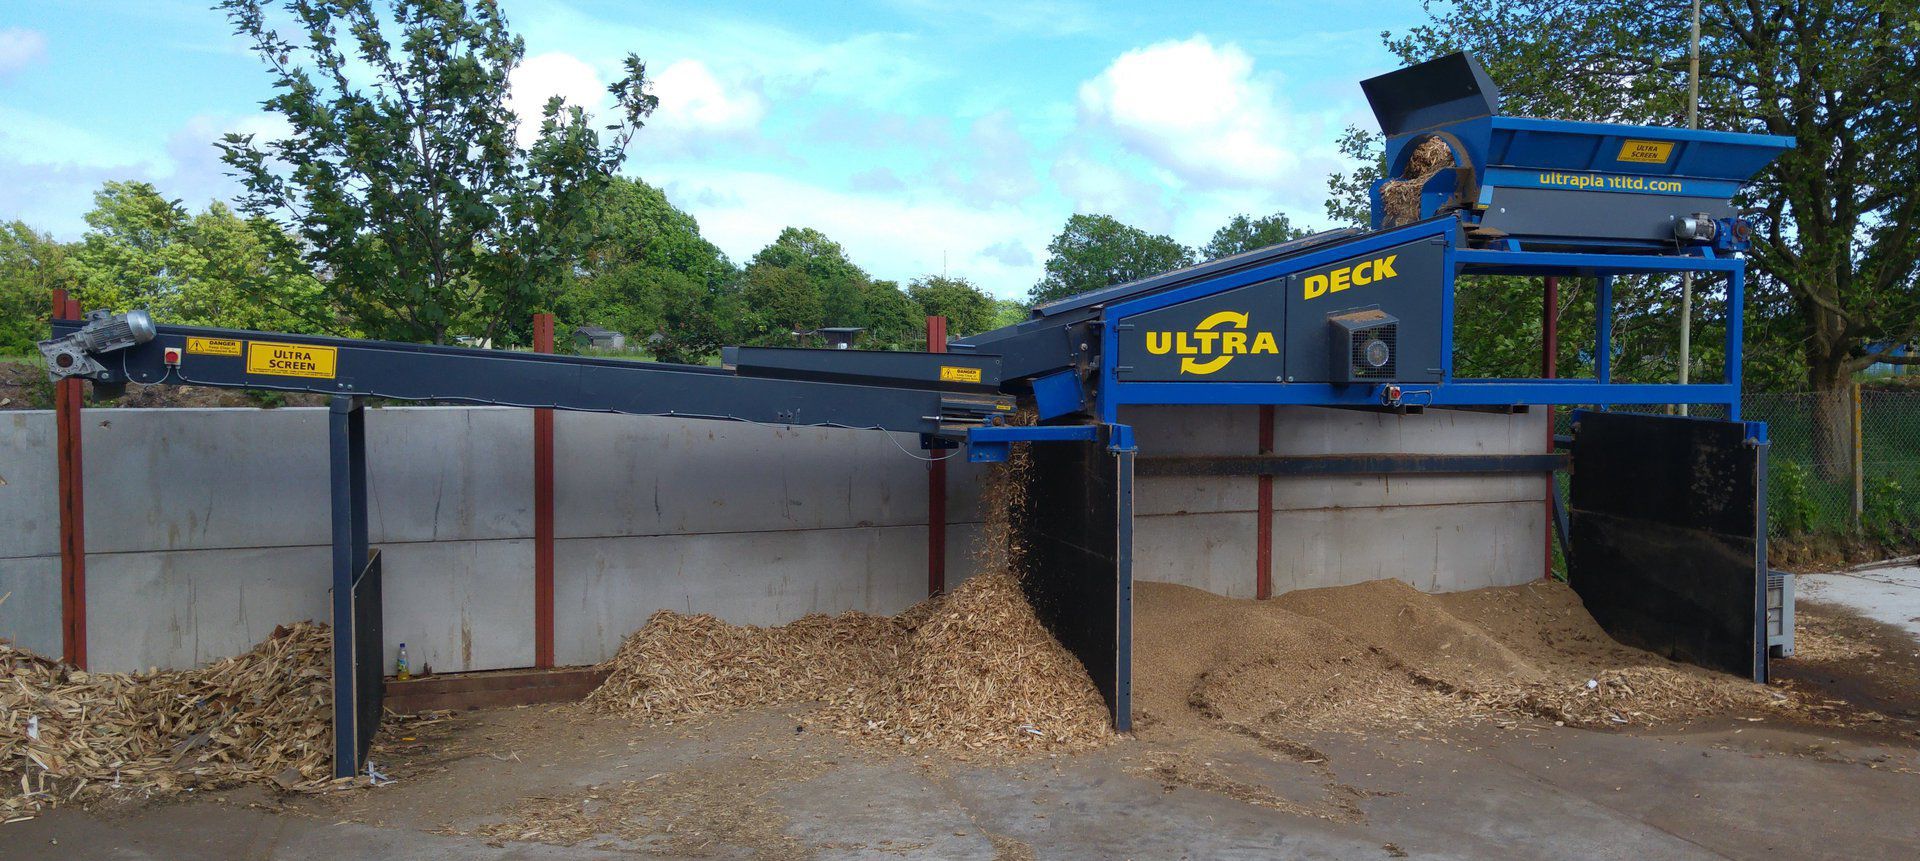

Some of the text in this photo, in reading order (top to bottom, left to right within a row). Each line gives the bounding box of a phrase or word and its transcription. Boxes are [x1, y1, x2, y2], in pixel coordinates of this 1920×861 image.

[1304, 255, 1398, 300] DECK
[1146, 331, 1279, 355] ULTRA
[274, 350, 311, 360] ULTRA
[269, 359, 316, 370] SCREEN
